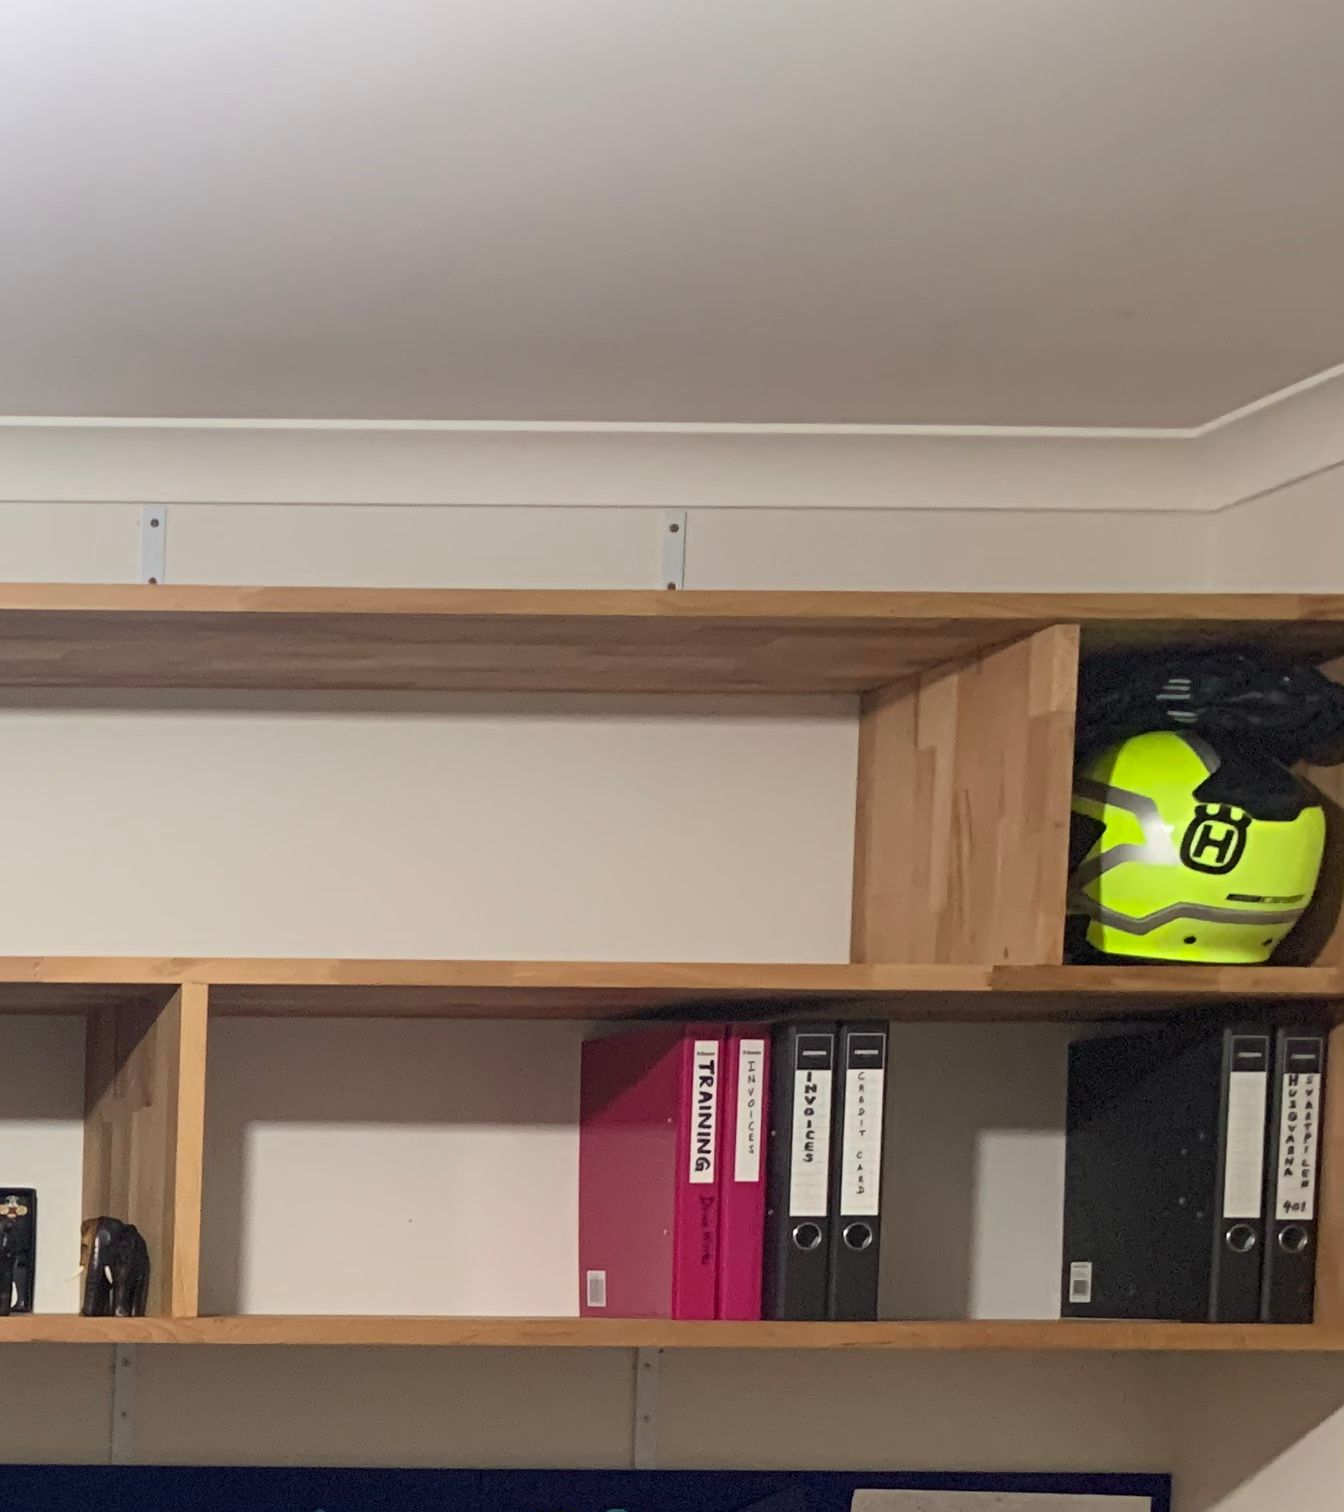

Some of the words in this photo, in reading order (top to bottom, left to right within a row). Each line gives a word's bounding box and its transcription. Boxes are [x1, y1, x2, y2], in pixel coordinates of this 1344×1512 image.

[1193, 823, 1235, 864] H
[694, 1059, 715, 1172] TRAINING
[747, 1060, 756, 1154] INVOICES
[802, 1071, 817, 1163] INVOICES
